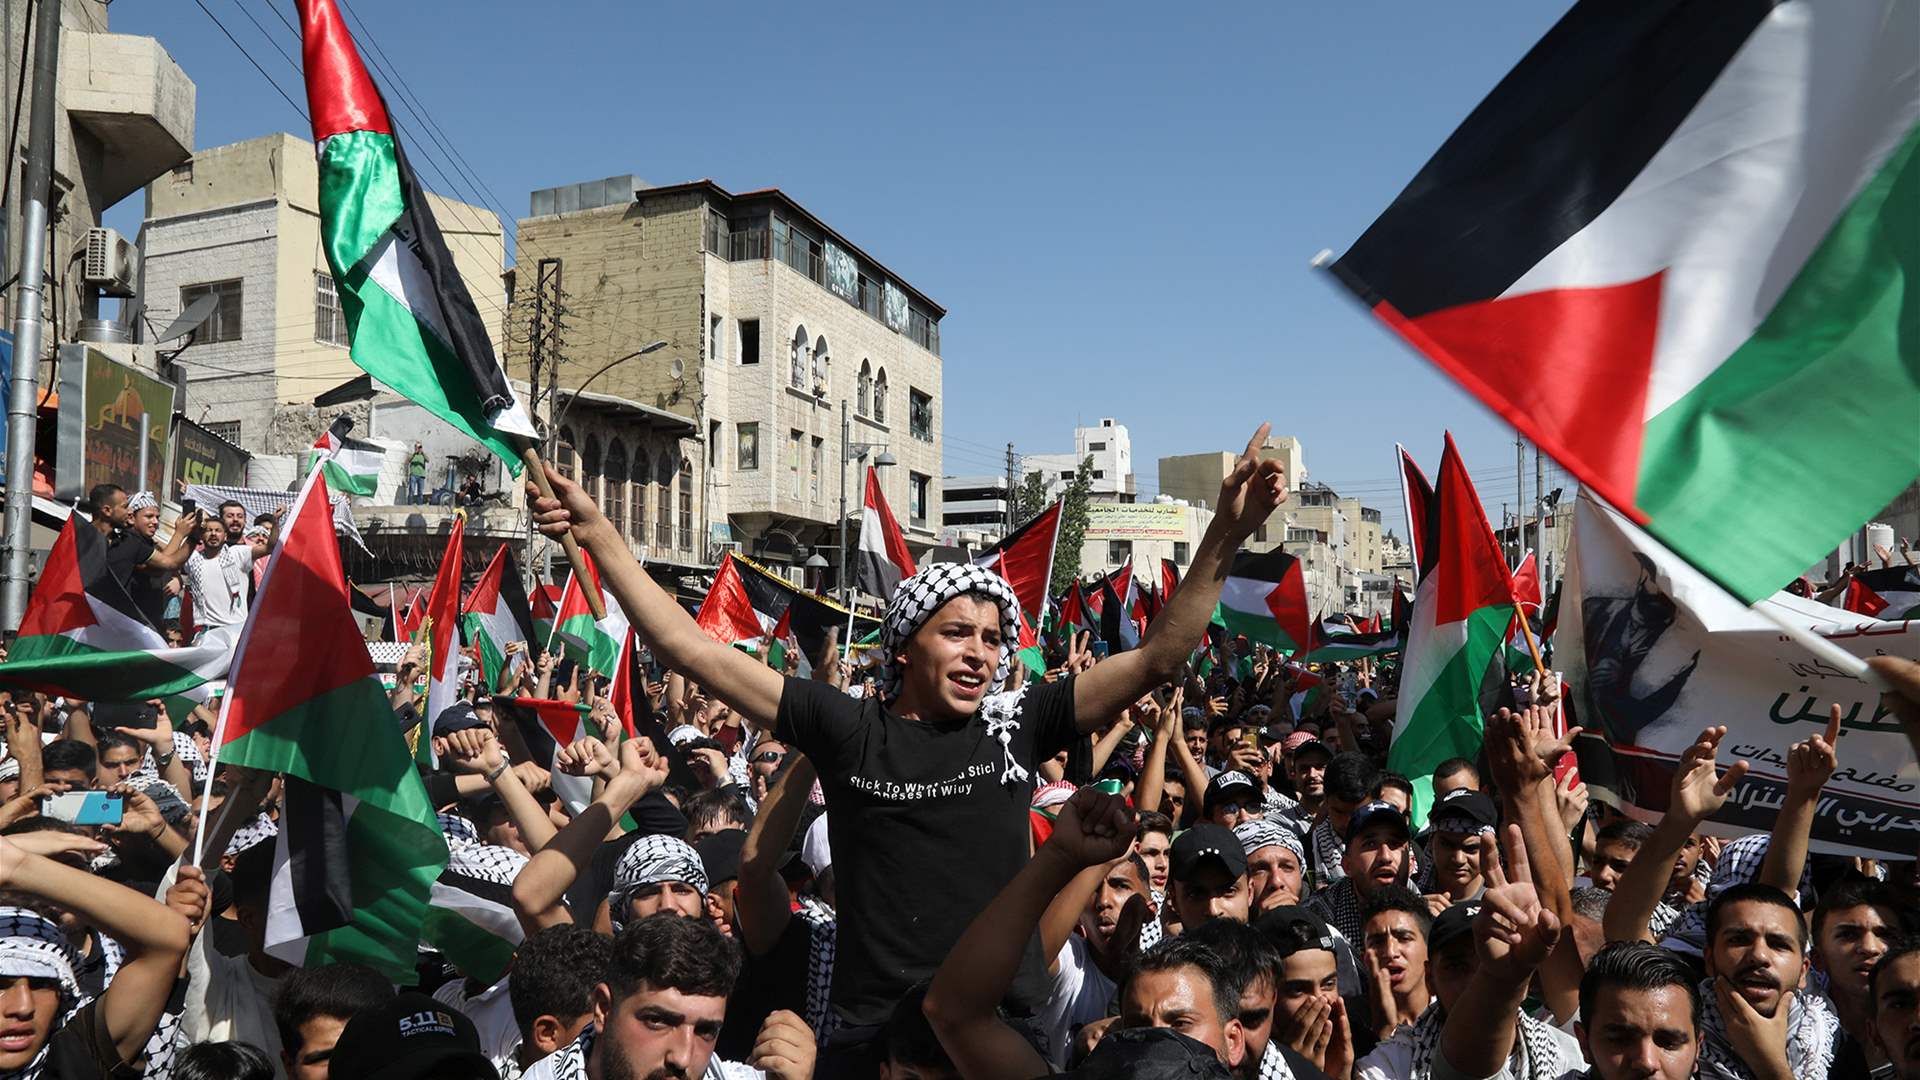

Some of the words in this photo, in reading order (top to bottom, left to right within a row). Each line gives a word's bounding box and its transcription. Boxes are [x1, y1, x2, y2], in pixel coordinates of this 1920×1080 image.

[850, 776, 881, 791] Stick
[886, 782, 901, 794] To
[399, 1010, 438, 1031] 5.11
